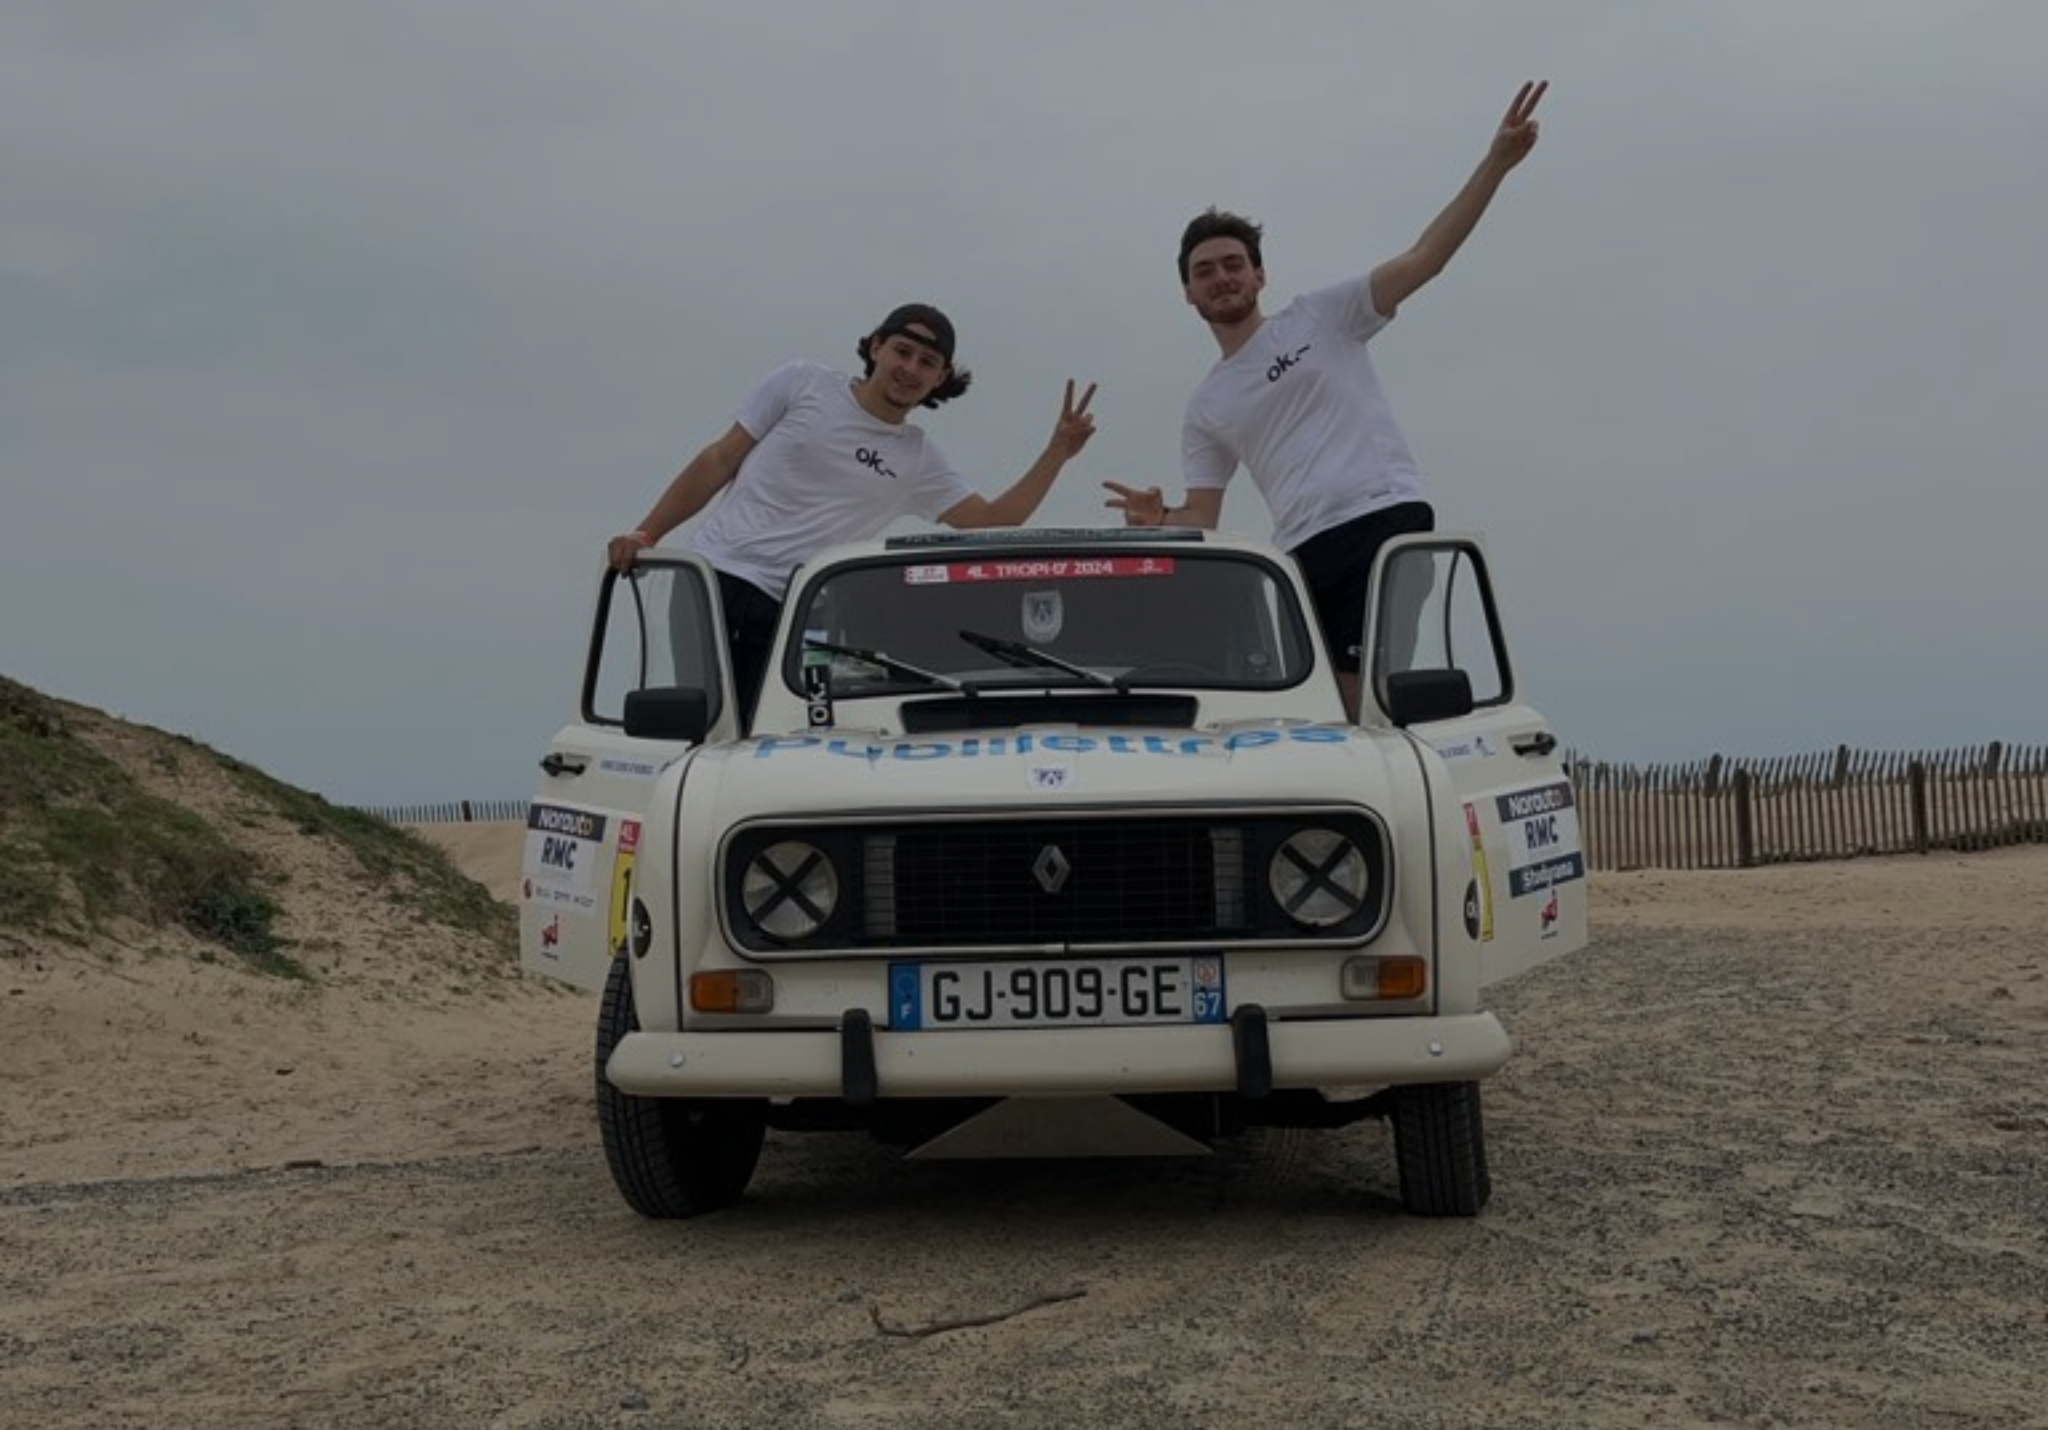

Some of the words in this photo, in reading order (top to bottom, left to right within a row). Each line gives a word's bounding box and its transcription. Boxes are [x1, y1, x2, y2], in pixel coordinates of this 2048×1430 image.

[996, 563, 1066, 578] TROPHY
[1074, 559, 1113, 576] 2024
[1508, 791, 1562, 816] Norauto
[538, 807, 594, 837] Norauto
[1524, 815, 1558, 849] RMC
[541, 837, 577, 871] RMC
[933, 965, 1182, 1021] GJ-909-GE
[1194, 991, 1221, 1017] 67
[901, 1003, 913, 1020] F
